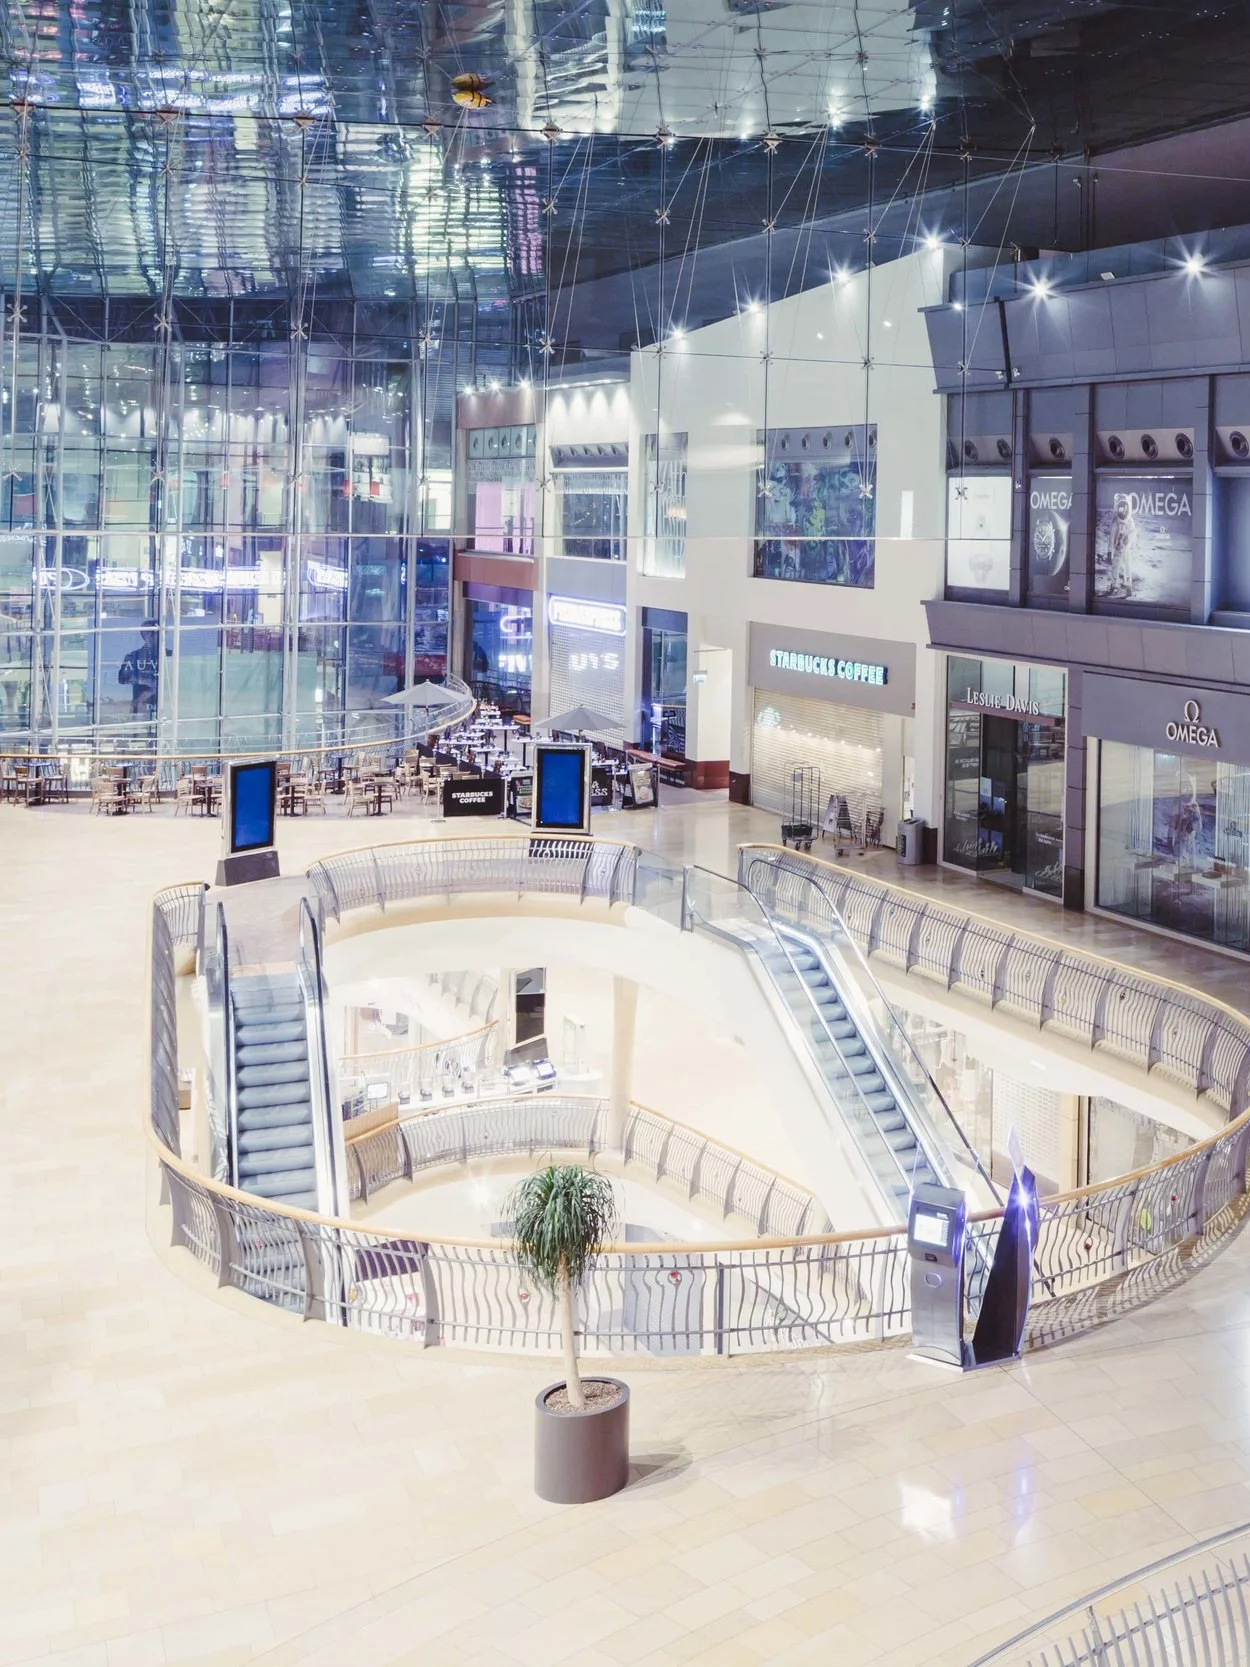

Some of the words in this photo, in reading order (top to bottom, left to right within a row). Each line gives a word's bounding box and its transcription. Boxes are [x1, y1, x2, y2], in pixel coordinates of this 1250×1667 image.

[769, 649, 836, 677] STARBUCKS
[837, 660, 884, 685] COFFEE
[1166, 722, 1219, 748] OMEGA
[451, 791, 493, 799] STARBUCKS
